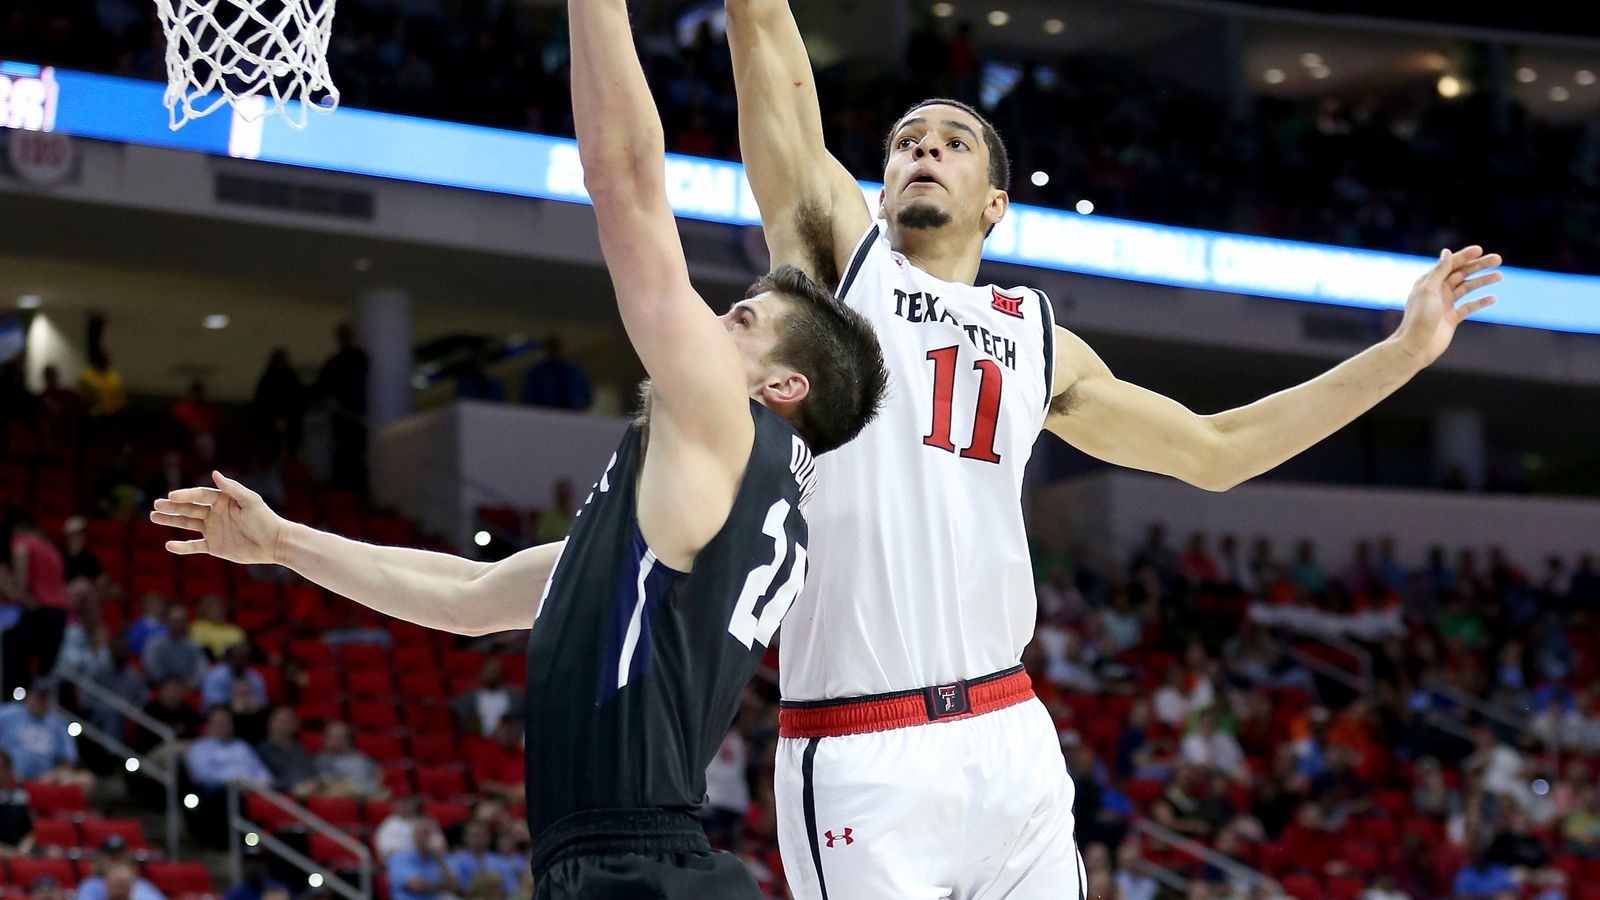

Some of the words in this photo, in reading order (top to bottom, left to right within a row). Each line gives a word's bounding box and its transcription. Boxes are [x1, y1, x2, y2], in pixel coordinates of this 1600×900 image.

[894, 288, 959, 326] TEXA
[963, 324, 1017, 371] TECH
[922, 344, 1003, 464] 11
